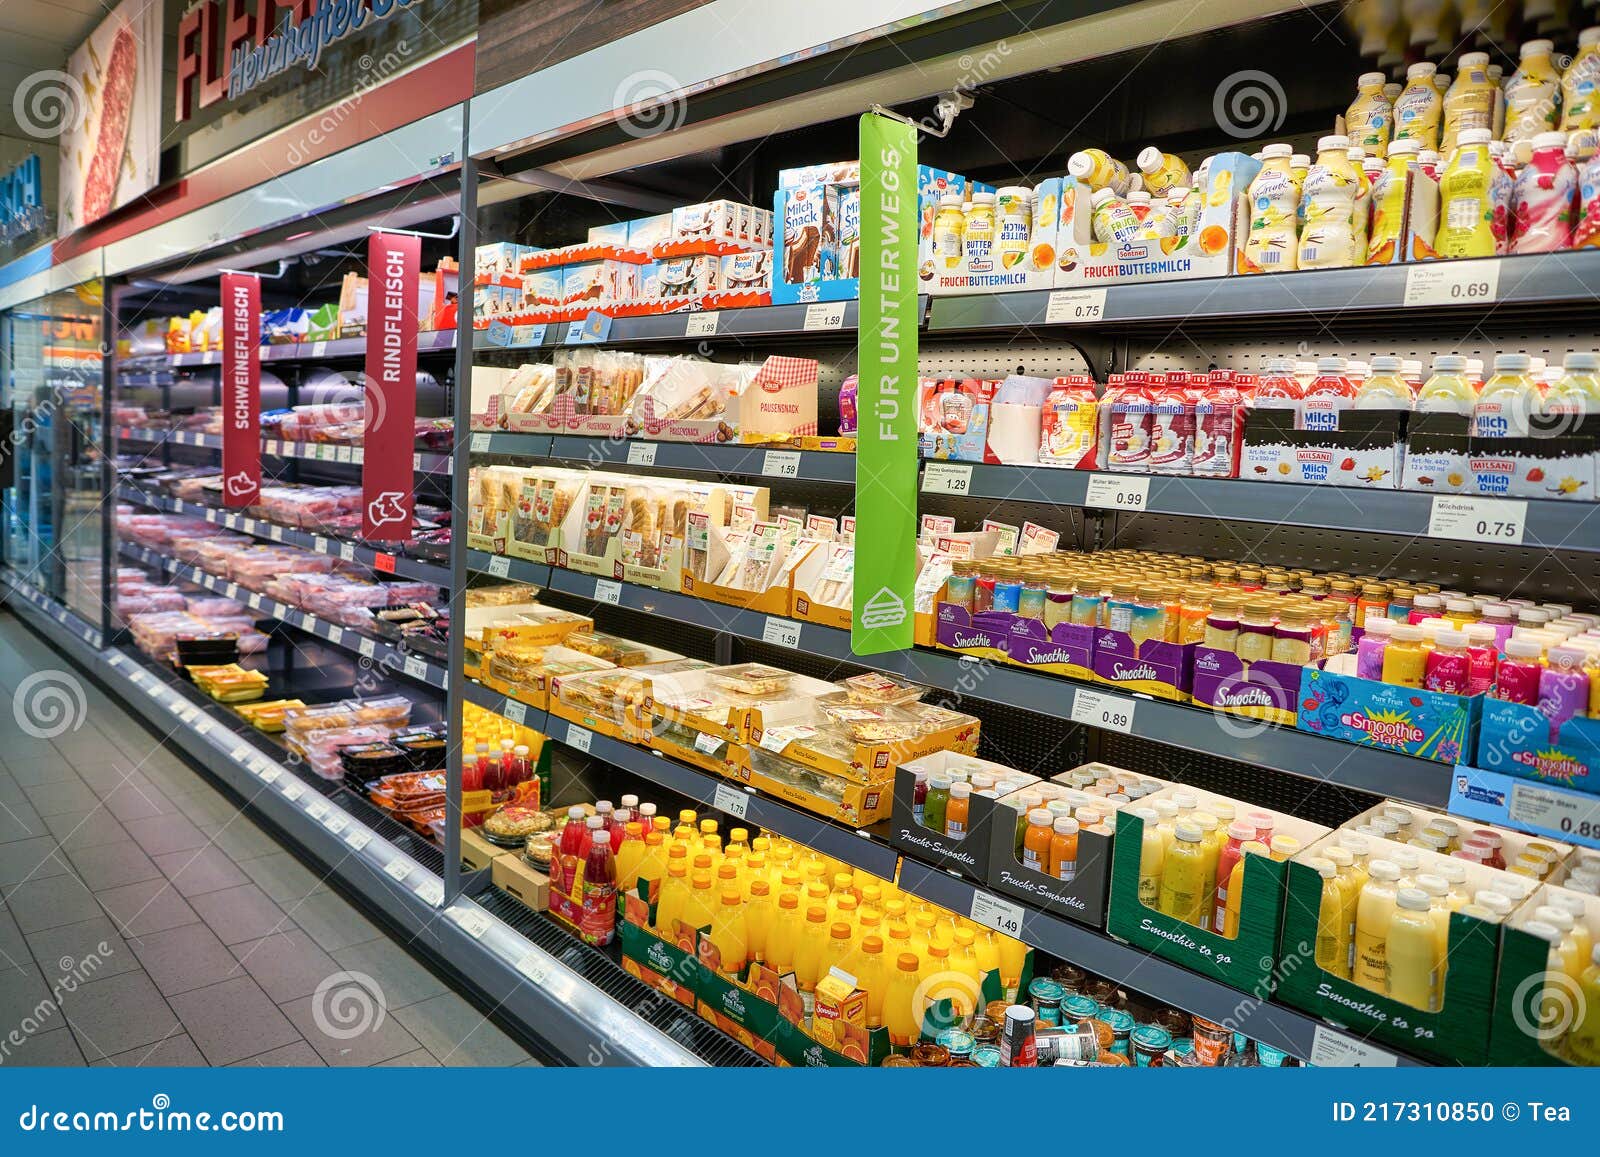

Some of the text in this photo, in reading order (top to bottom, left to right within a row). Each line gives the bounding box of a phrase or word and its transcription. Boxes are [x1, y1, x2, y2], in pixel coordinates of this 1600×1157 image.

[787, 200, 813, 215] Milch
[785, 210, 818, 228] Snack
[966, 240, 992, 249] BUTTER
[1084, 259, 1191, 278] FRUCHTBUTTERMILCH
[940, 273, 1026, 287] FRUCHTBUTTERMILCH
[874, 146, 899, 440] FÜR UNTERWEGS
[1451, 282, 1489, 298] 0.69
[383, 250, 405, 382] RINDFLEISCH
[1075, 305, 1100, 318] 0.75
[702, 323, 715, 332] 1.99
[824, 315, 841, 326] 1.59
[234, 287, 250, 430] SCHWEINEFLEISCH
[1304, 412, 1337, 425] Milch
[641, 453, 653, 463] 1.15
[1298, 452, 1331, 461] MILSANI
[780, 464, 796, 474] 1.59
[1302, 463, 1328, 474] Milch
[1473, 461, 1513, 471] MILSANI
[946, 479, 966, 490] 1.29
[1304, 472, 1327, 481] Drink
[1477, 474, 1509, 485] Milch
[1480, 483, 1508, 492] Drink
[1116, 492, 1142, 505] 0.99
[1476, 520, 1516, 537] 0.75
[782, 633, 797, 645] 1.59
[952, 631, 991, 648] Smoothie
[1026, 646, 1070, 664] Smoothie
[1110, 661, 1157, 681] Smoothie
[1215, 685, 1272, 706] Smoothie
[1102, 711, 1128, 727] 0.89
[1351, 712, 1423, 742] Smoothie
[1371, 731, 1405, 747] Stars
[1521, 751, 1590, 777] Smoothie
[730, 802, 744, 815] 1.79
[1560, 817, 1600, 839] 0.89
[900, 829, 976, 866] Frucht-Smoothie
[1000, 871, 1086, 910] Frucht-Smoothie
[996, 914, 1018, 932] 1.49
[1140, 918, 1232, 964] Smoothie to go
[1316, 983, 1435, 1039] Smoothie to go
